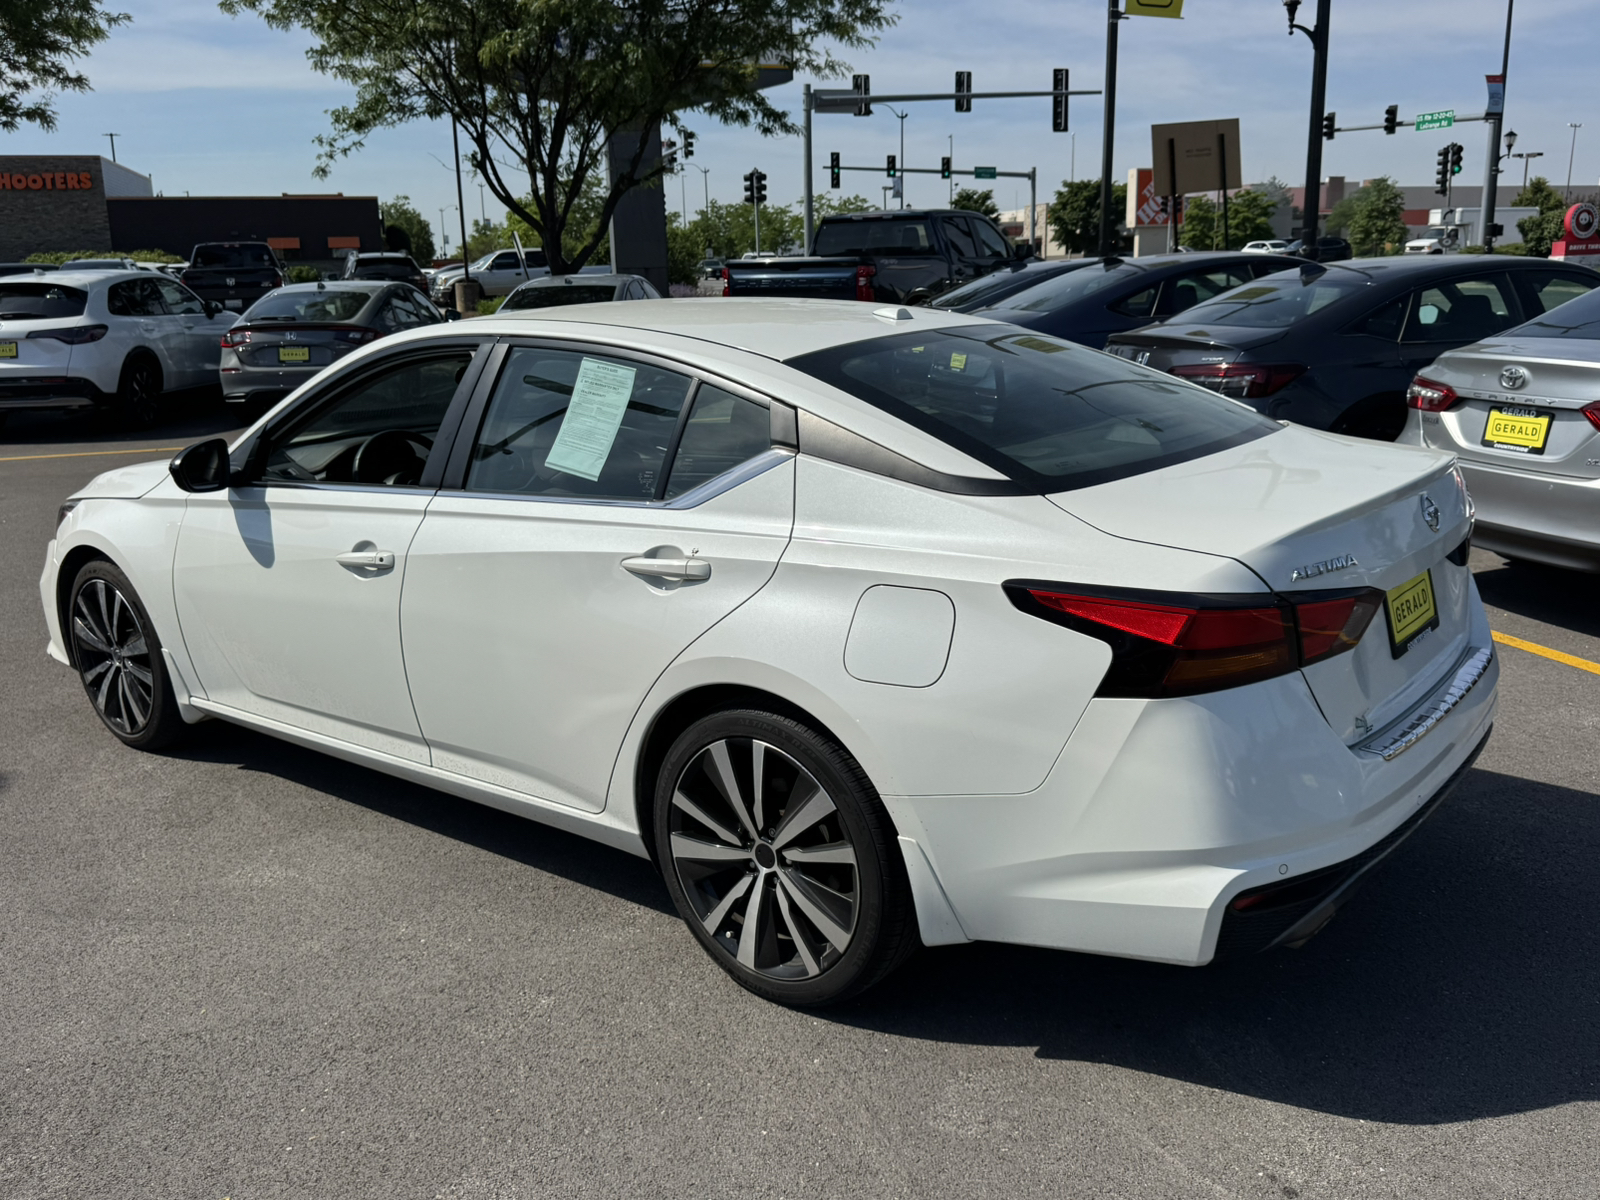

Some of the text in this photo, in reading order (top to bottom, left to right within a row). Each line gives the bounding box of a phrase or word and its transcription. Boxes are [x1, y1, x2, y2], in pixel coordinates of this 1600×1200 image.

[0, 172, 92, 190] HOOTERS
[1502, 407, 1537, 418] GERALD
[1495, 422, 1538, 437] GERALD
[1291, 554, 1359, 583] ALTIMA
[1395, 588, 1428, 623] GERALD
